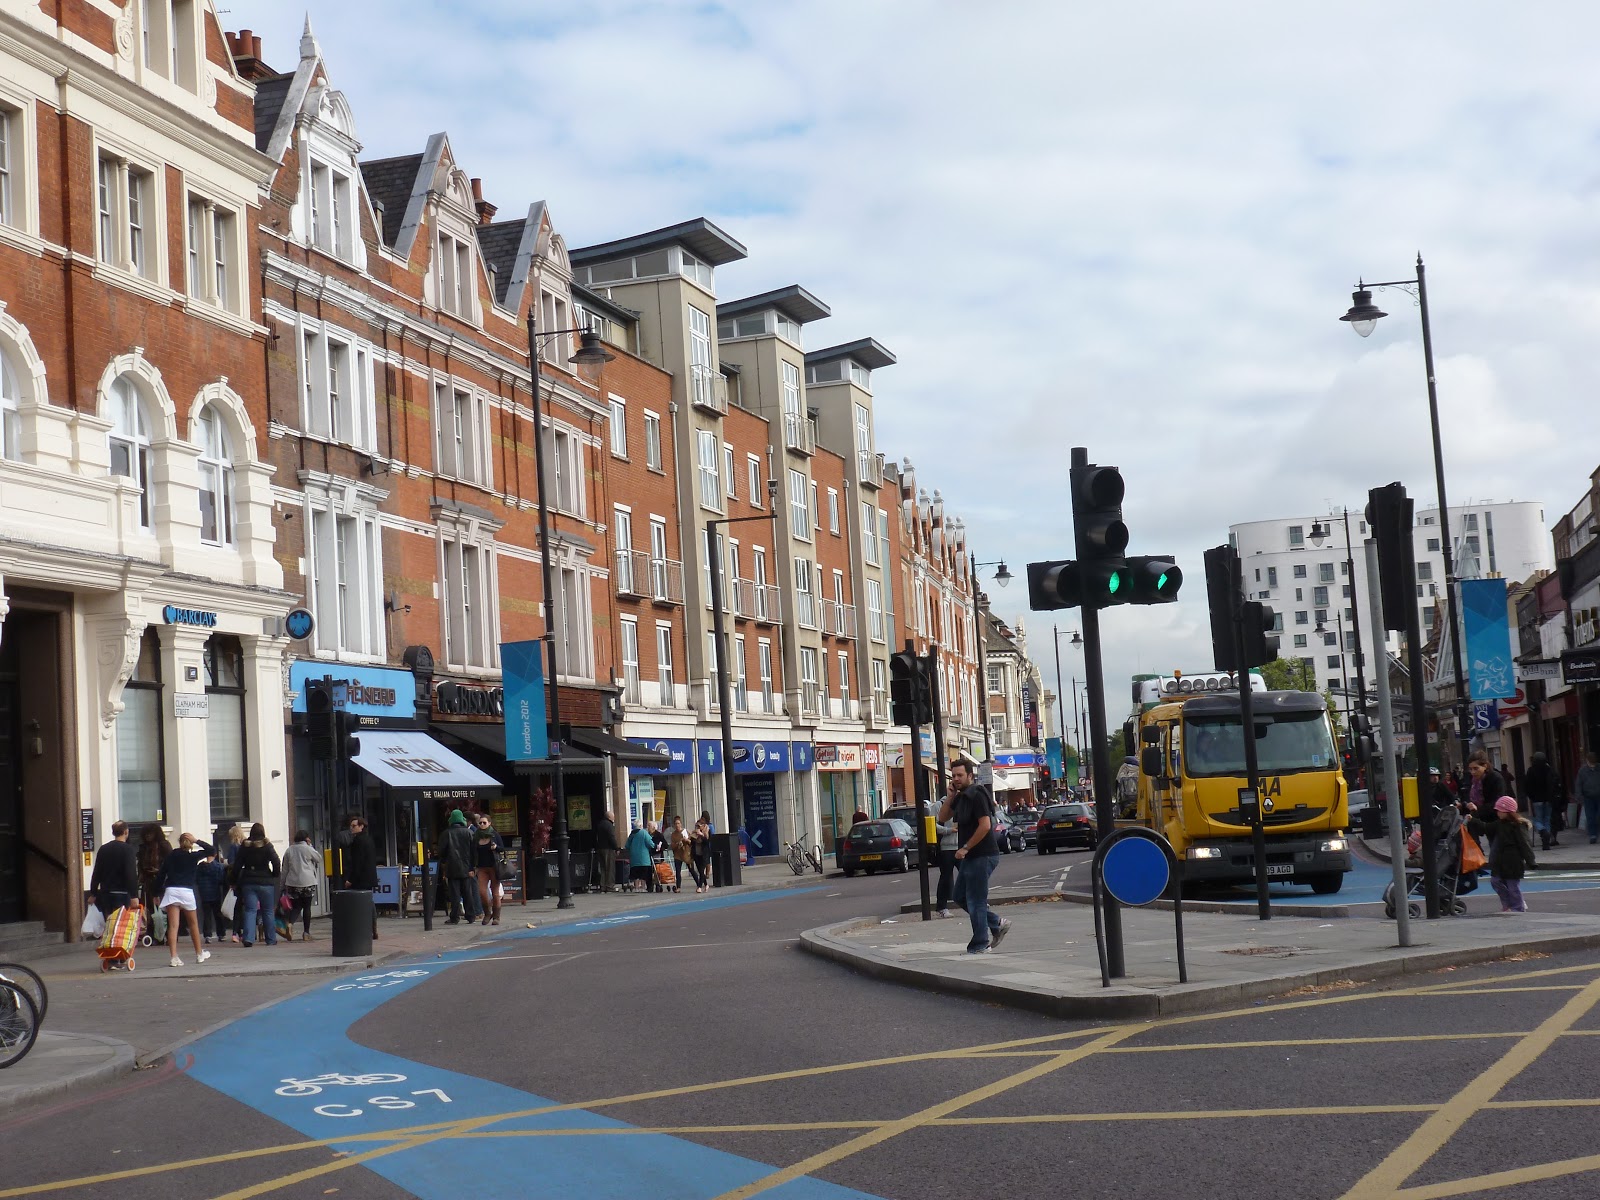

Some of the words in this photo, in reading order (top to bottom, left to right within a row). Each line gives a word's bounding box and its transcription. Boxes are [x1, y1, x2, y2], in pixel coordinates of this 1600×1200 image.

[176, 608, 217, 627] BARCLAYS
[176, 700, 195, 708] CLAPHAM
[197, 701, 208, 709] HIGH
[521, 699, 530, 720] 2012
[1476, 711, 1491, 730] S
[522, 721, 532, 755] London
[380, 758, 453, 774] NERO
[423, 790, 432, 799] THE
[452, 790, 469, 798] COFFEE
[1258, 777, 1281, 797] AA
[373, 884, 392, 894] RO
[313, 1087, 453, 1118] CS7
